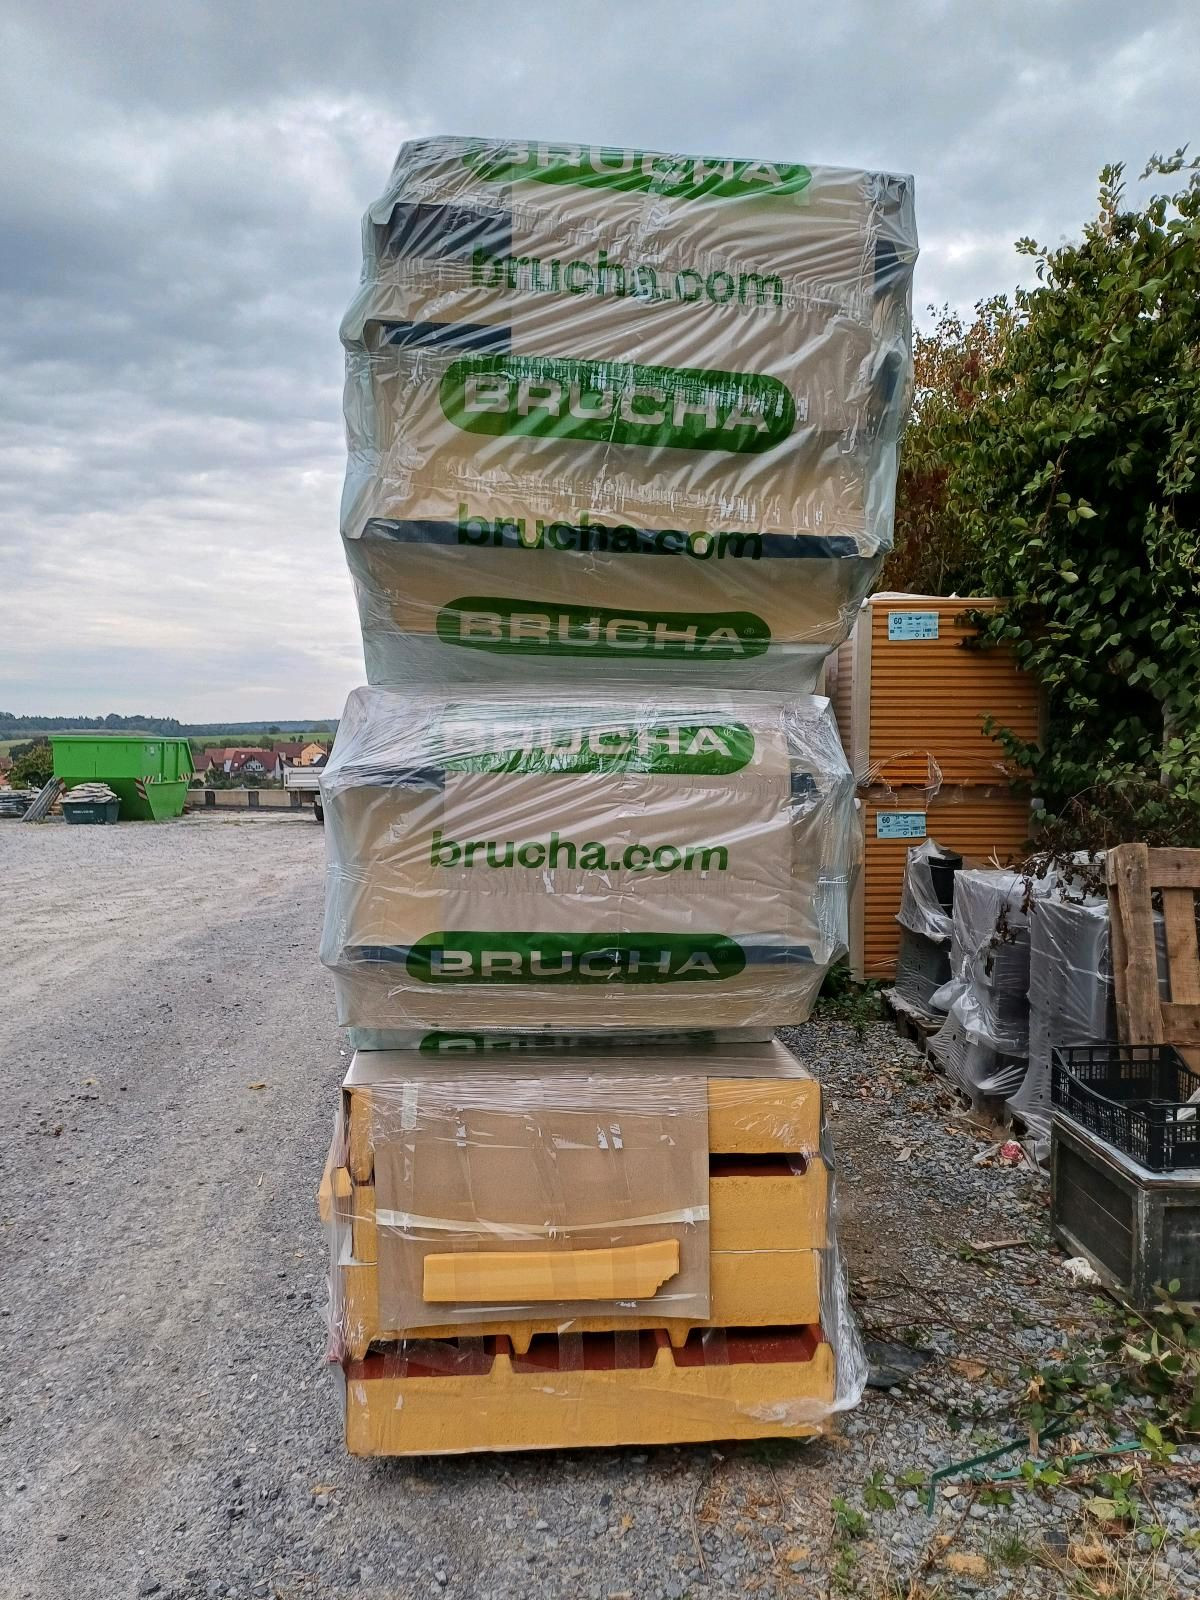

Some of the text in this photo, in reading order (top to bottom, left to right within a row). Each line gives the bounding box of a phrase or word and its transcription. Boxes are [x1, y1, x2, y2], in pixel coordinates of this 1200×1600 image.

[472, 242, 783, 306] brucha.com
[463, 377, 770, 433] BRUCHA
[457, 503, 763, 561] brucha.com
[459, 611, 746, 653] BRUCHA
[893, 617, 903, 625] 60
[450, 724, 732, 756] RUCHA
[881, 816, 891, 824] 60
[431, 831, 728, 871] brucha.com
[430, 950, 720, 977] BRUCHA
